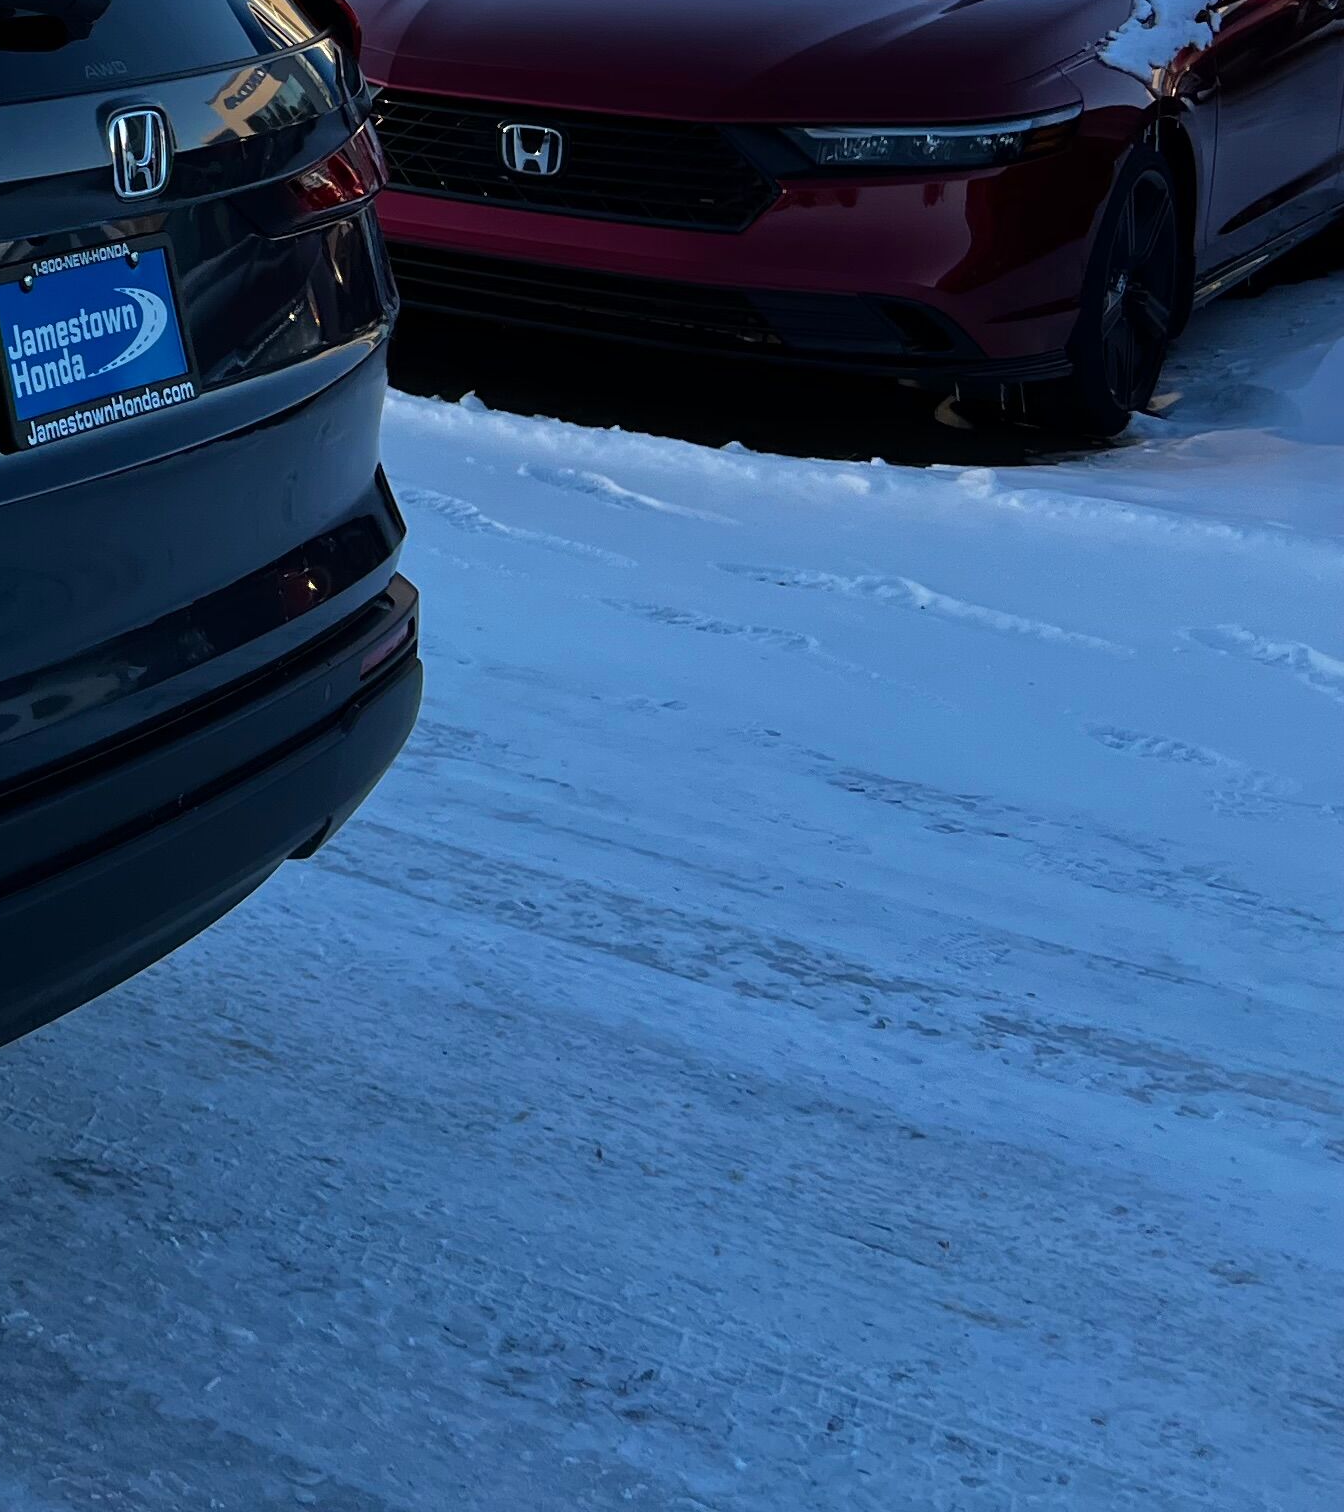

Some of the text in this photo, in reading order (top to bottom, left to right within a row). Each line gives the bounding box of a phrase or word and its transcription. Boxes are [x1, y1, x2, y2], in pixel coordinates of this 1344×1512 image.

[84, 60, 128, 80] AWD
[31, 242, 131, 276] 1-800-NEW-HONDA
[8, 303, 138, 360] Jamestown
[10, 348, 86, 398] Honda
[27, 381, 195, 446] JamestownHonda.com
